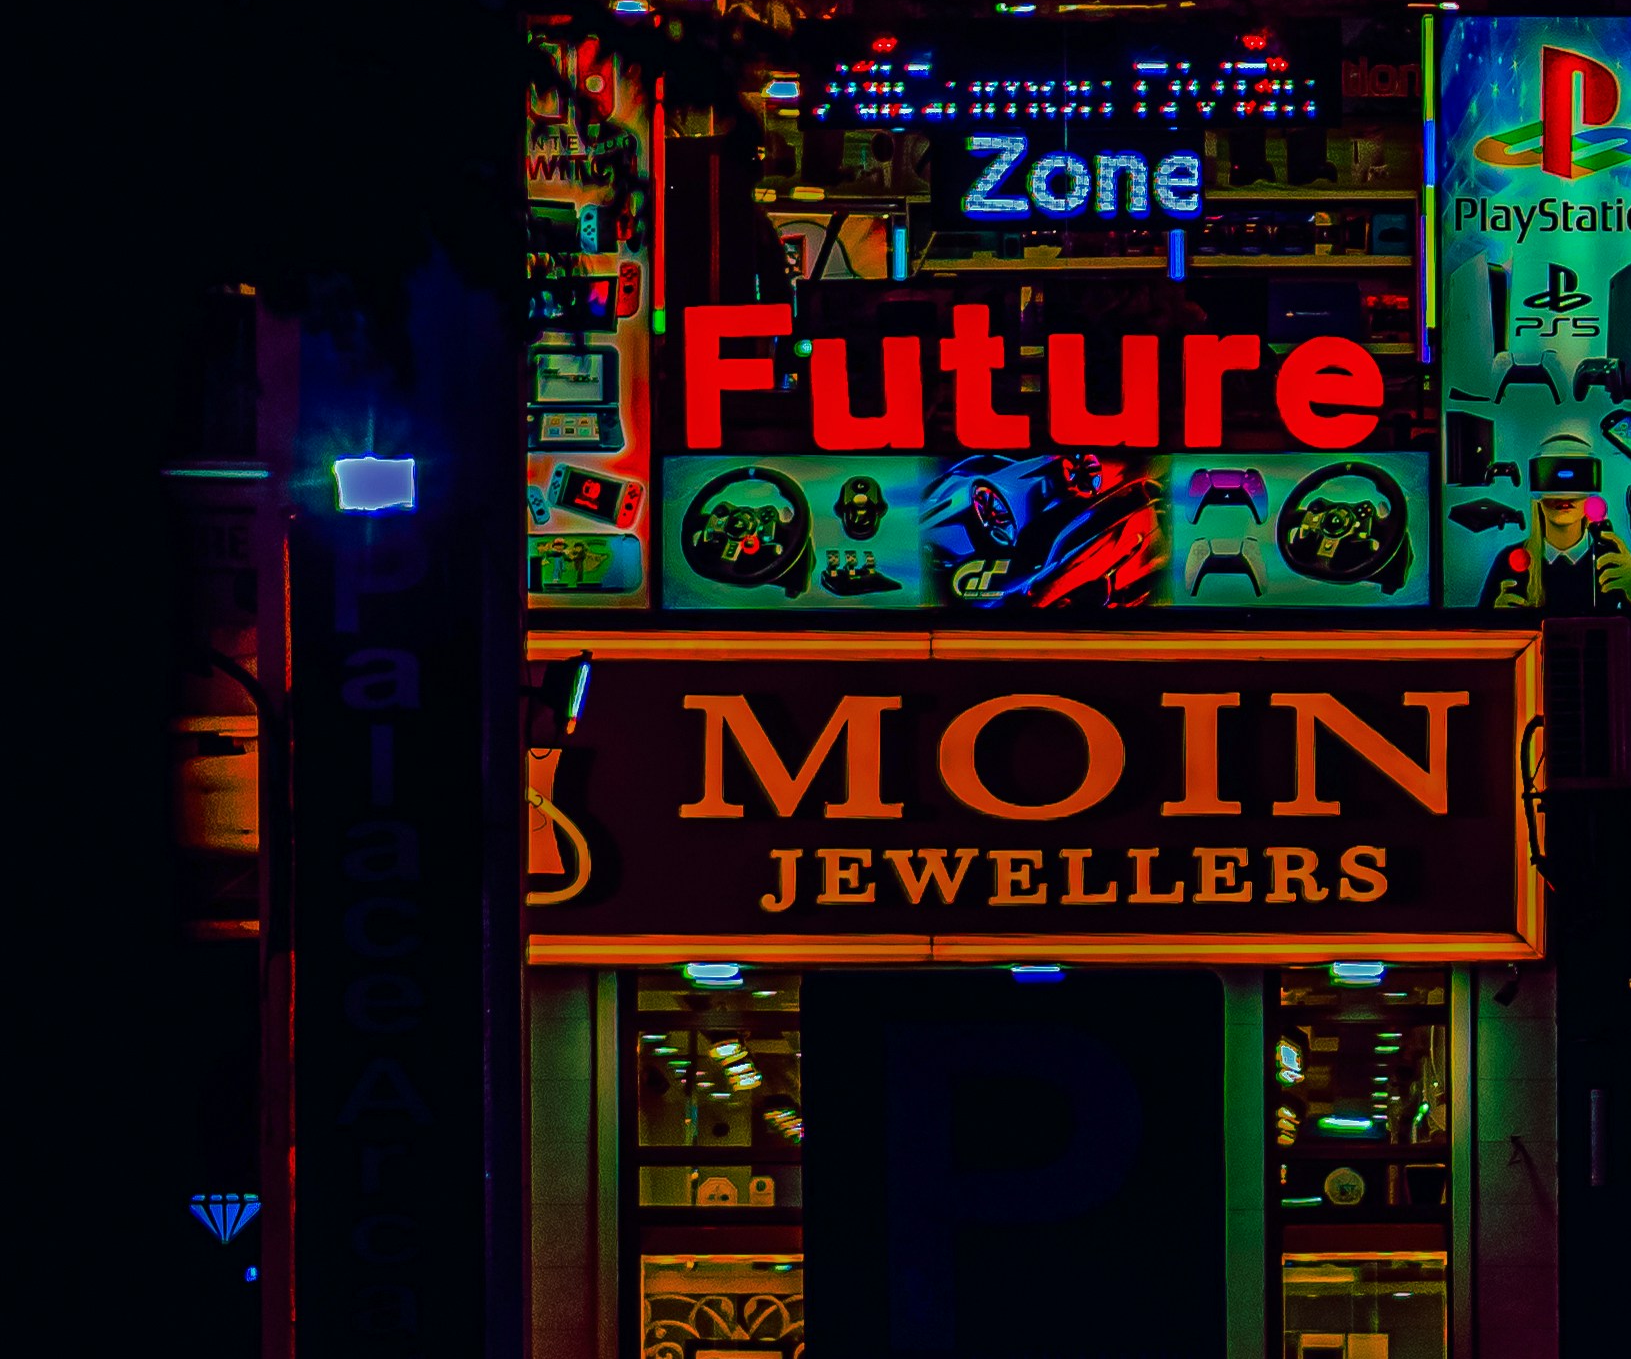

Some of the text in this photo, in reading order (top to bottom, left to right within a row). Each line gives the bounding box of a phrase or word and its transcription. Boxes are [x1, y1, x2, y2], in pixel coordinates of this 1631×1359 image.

[964, 134, 1202, 217] Zone
[1515, 317, 1600, 338] PS5
[684, 303, 1384, 449] Future
[678, 690, 1471, 821] MOIN
[760, 845, 1389, 913] JEWELLERS
